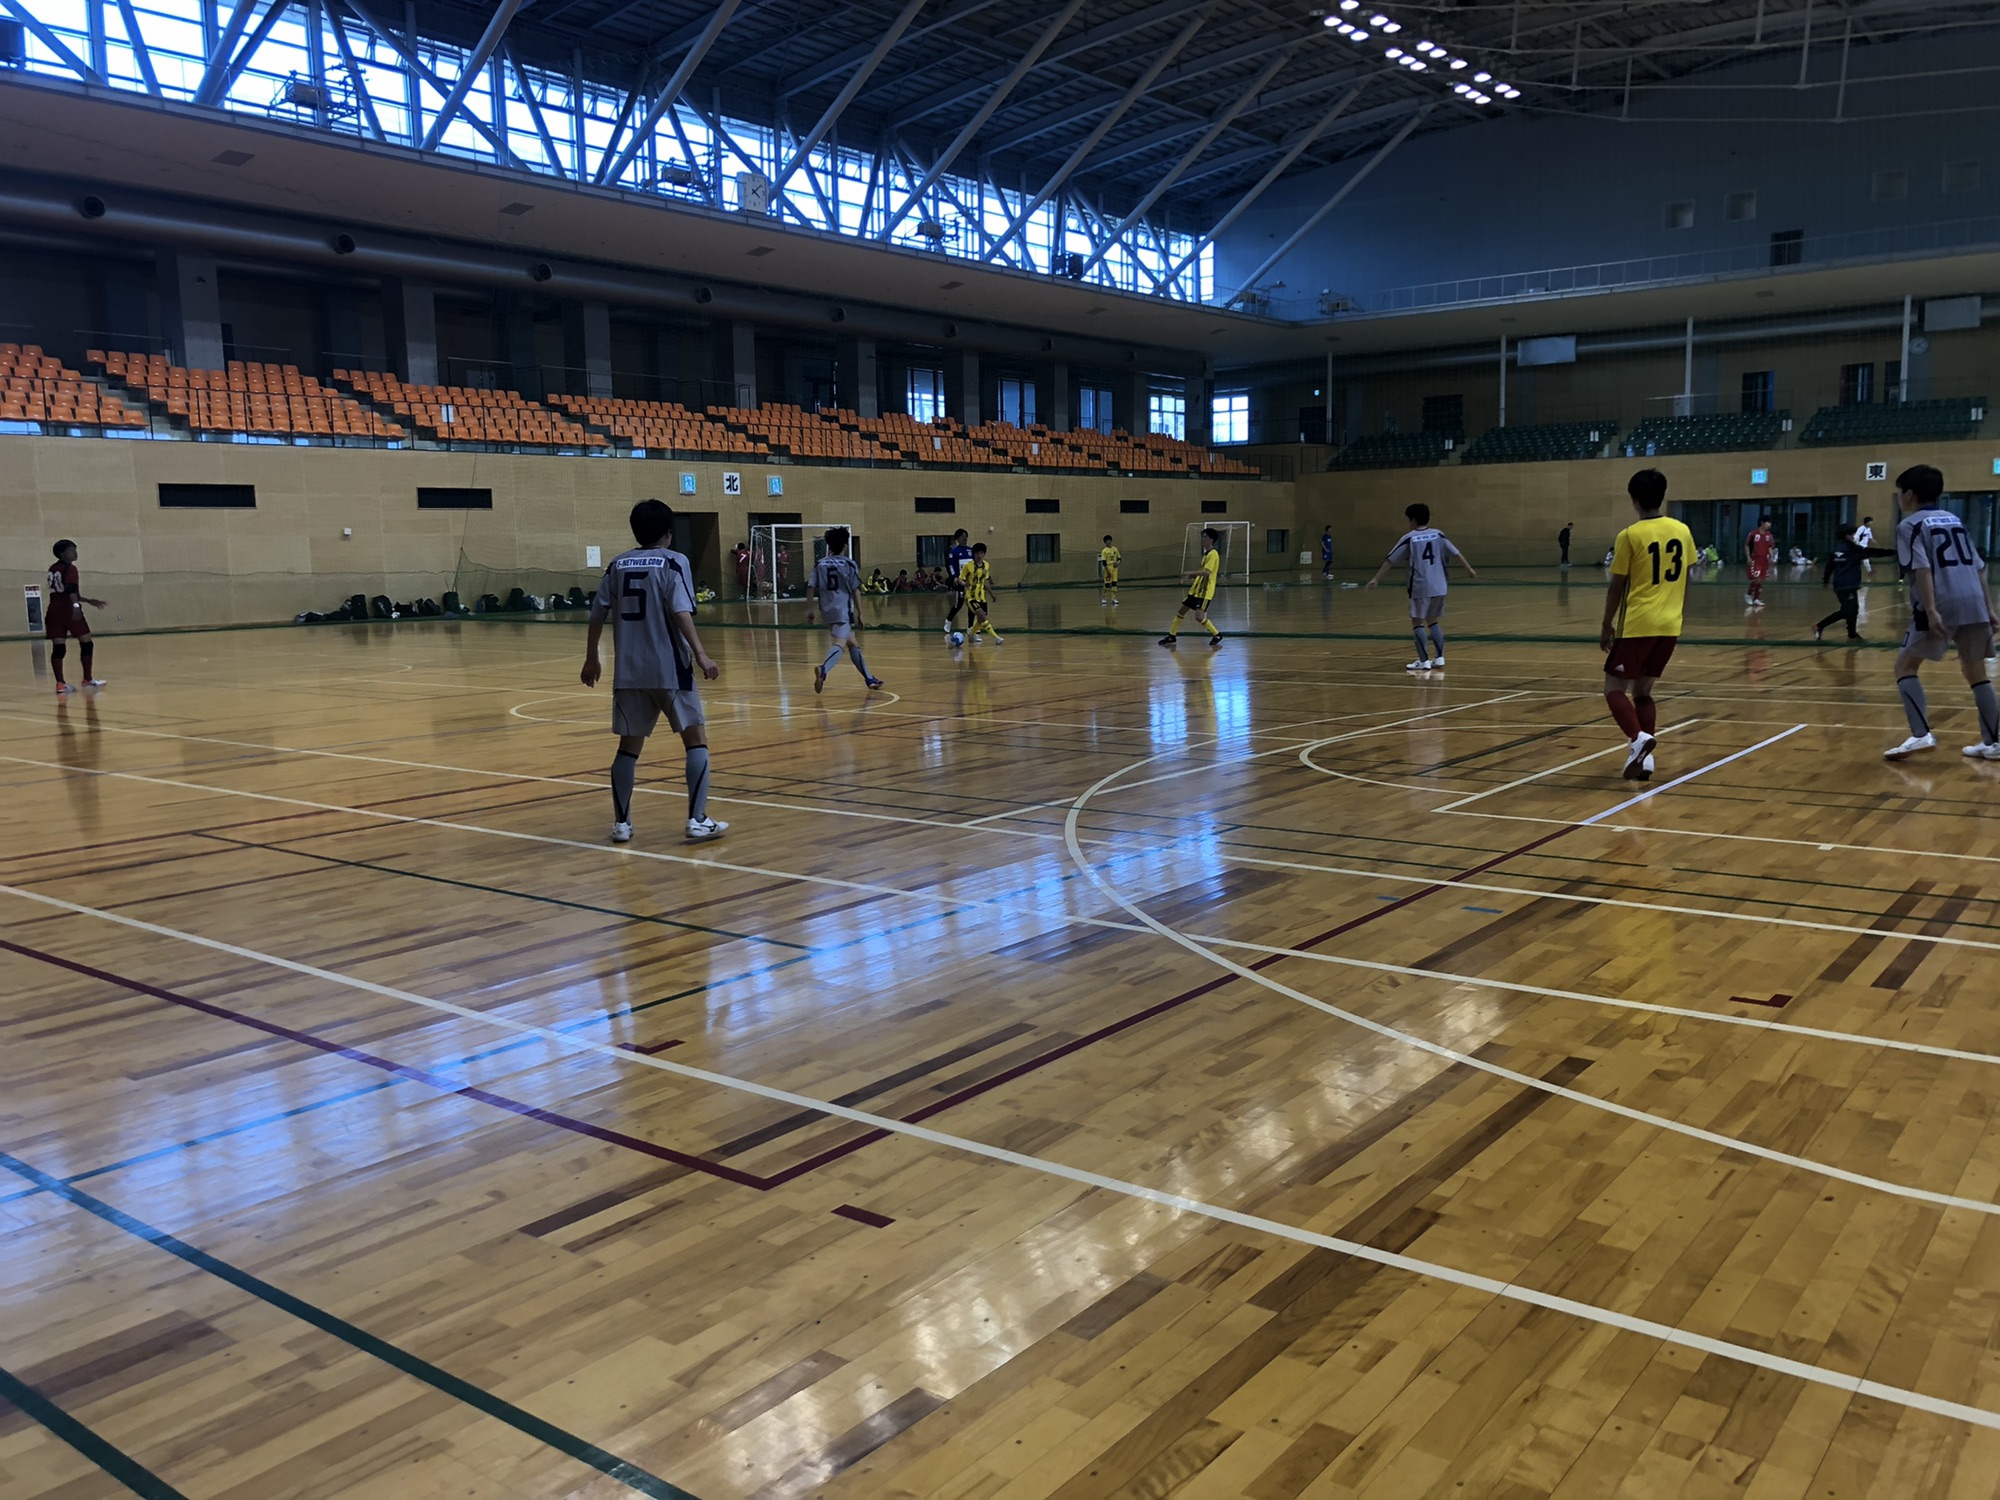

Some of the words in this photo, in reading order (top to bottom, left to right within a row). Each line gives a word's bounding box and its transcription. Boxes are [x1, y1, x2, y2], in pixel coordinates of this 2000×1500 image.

[725, 475, 738, 492] 北
[1868, 464, 1884, 479] 東
[739, 553, 747, 563] 7
[1422, 541, 1435, 566] 4
[1930, 527, 1973, 569] 20
[1647, 538, 1683, 585] 13
[826, 566, 839, 591] 6
[621, 571, 650, 621] 5
